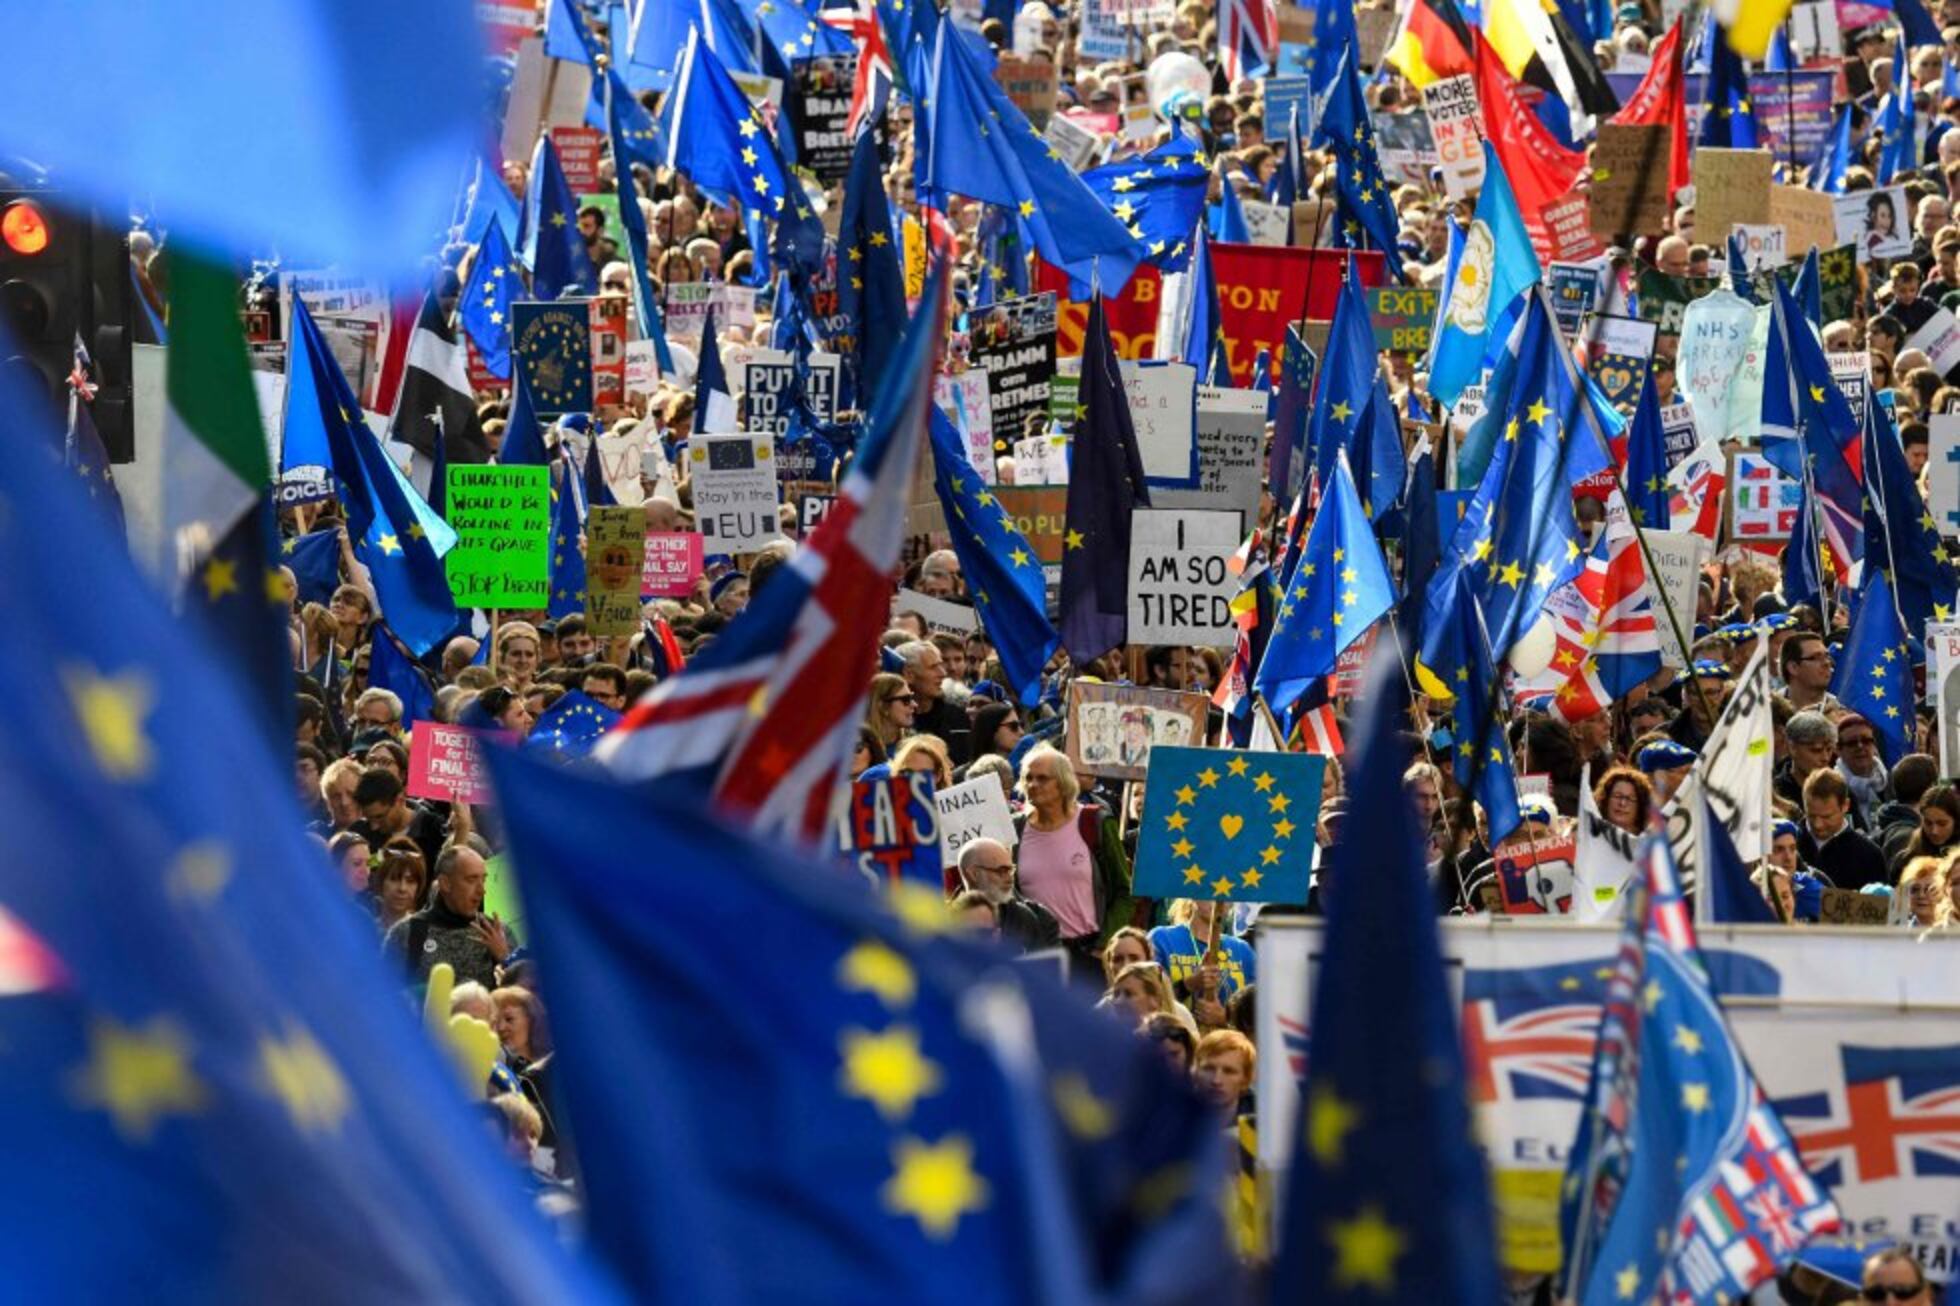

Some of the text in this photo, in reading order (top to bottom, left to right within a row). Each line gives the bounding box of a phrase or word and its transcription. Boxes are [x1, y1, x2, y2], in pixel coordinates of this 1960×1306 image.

[1425, 79, 1473, 102] MORE
[1392, 326, 1428, 349] BRE
[1697, 321, 1738, 341] NHS
[749, 393, 778, 416] TO
[991, 382, 1050, 410] RETMES
[450, 467, 537, 488] CHURCHILL
[451, 492, 513, 511] WOULD
[697, 488, 774, 504] Stay in the
[524, 518, 543, 531] IN
[719, 511, 756, 539] EU
[1177, 519, 1185, 550] I
[1139, 556, 1226, 586] AM SO
[450, 572, 499, 597] STOP
[431, 759, 466, 777] FINAL
[939, 788, 986, 815] INAL
